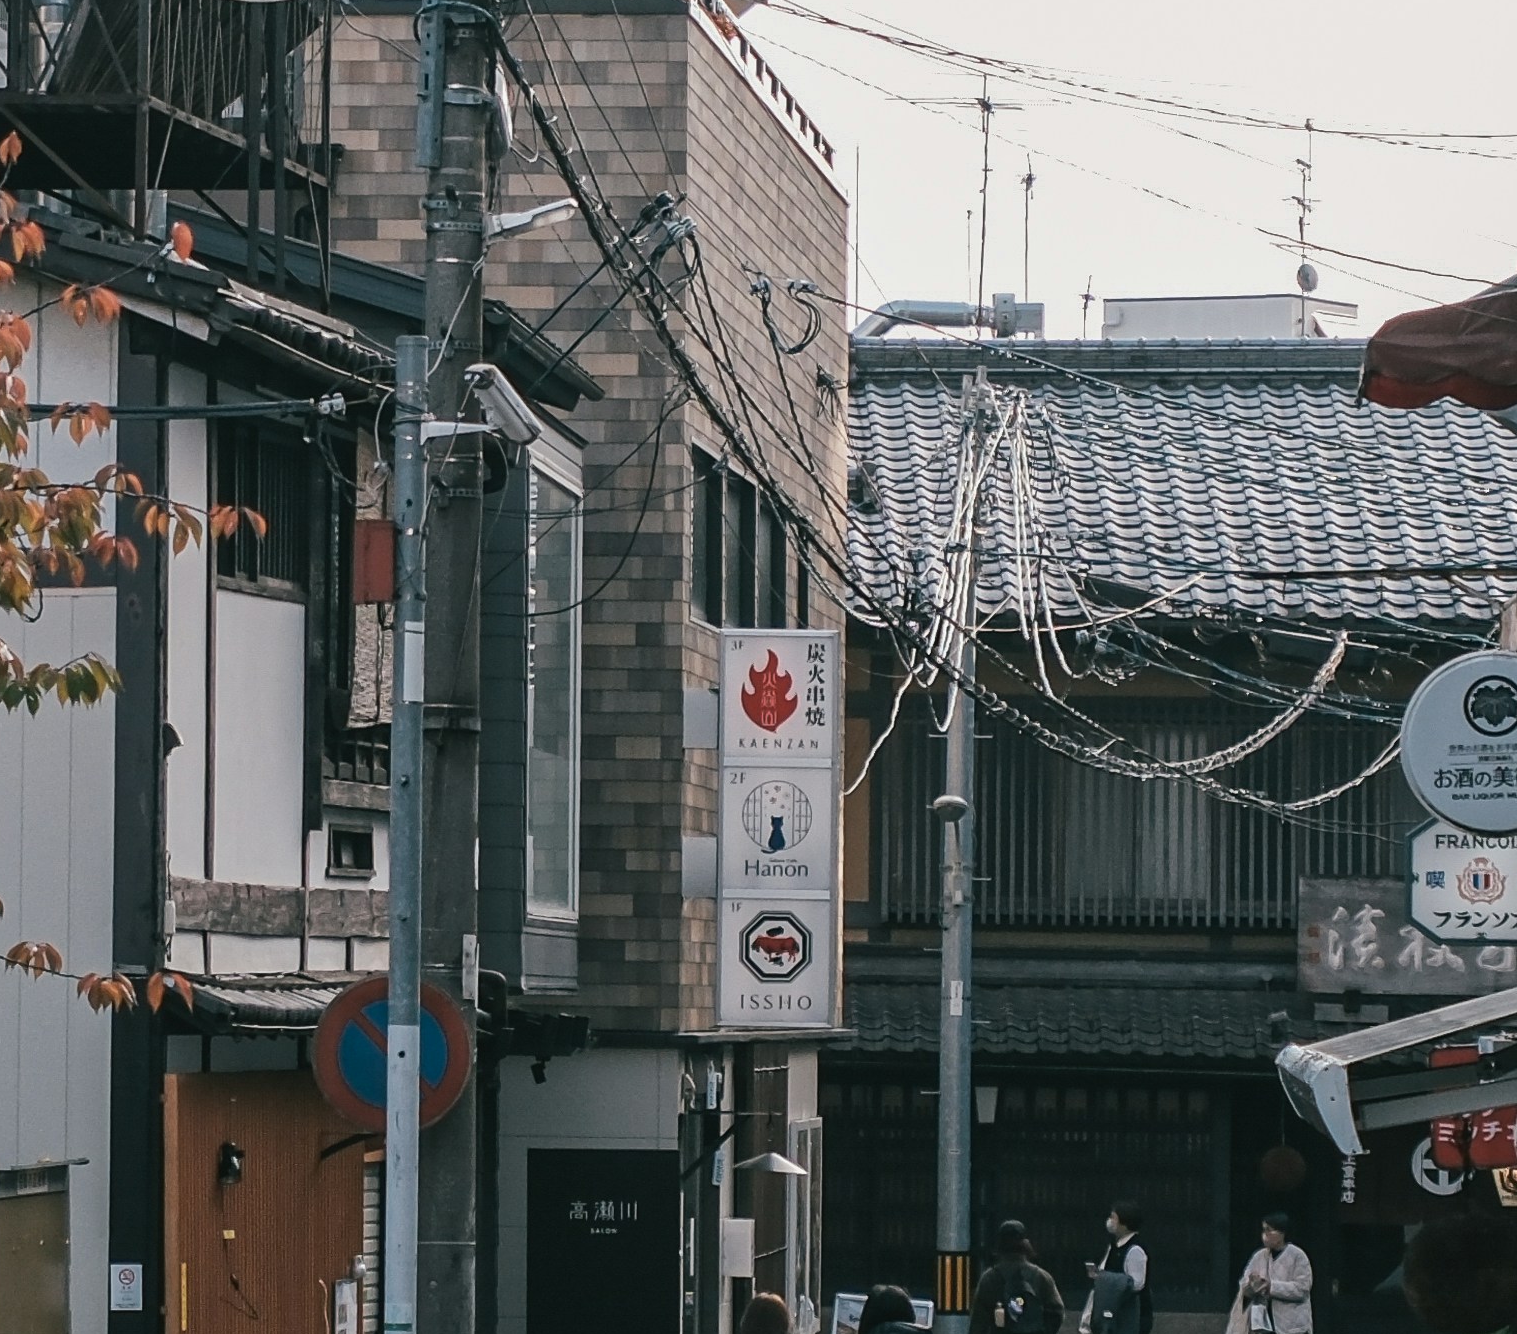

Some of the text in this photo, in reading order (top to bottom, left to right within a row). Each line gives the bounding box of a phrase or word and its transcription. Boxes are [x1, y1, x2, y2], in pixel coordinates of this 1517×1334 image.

[805, 642, 827, 727] 炭火串焼
[738, 738, 819, 749] KAENZAN
[729, 772, 746, 785] 2F
[1473, 792, 1505, 800] LIQUOR
[744, 859, 809, 878] Hanon
[740, 994, 813, 1010] ISSHO
[569, 1200, 637, 1221] 高瀬川
